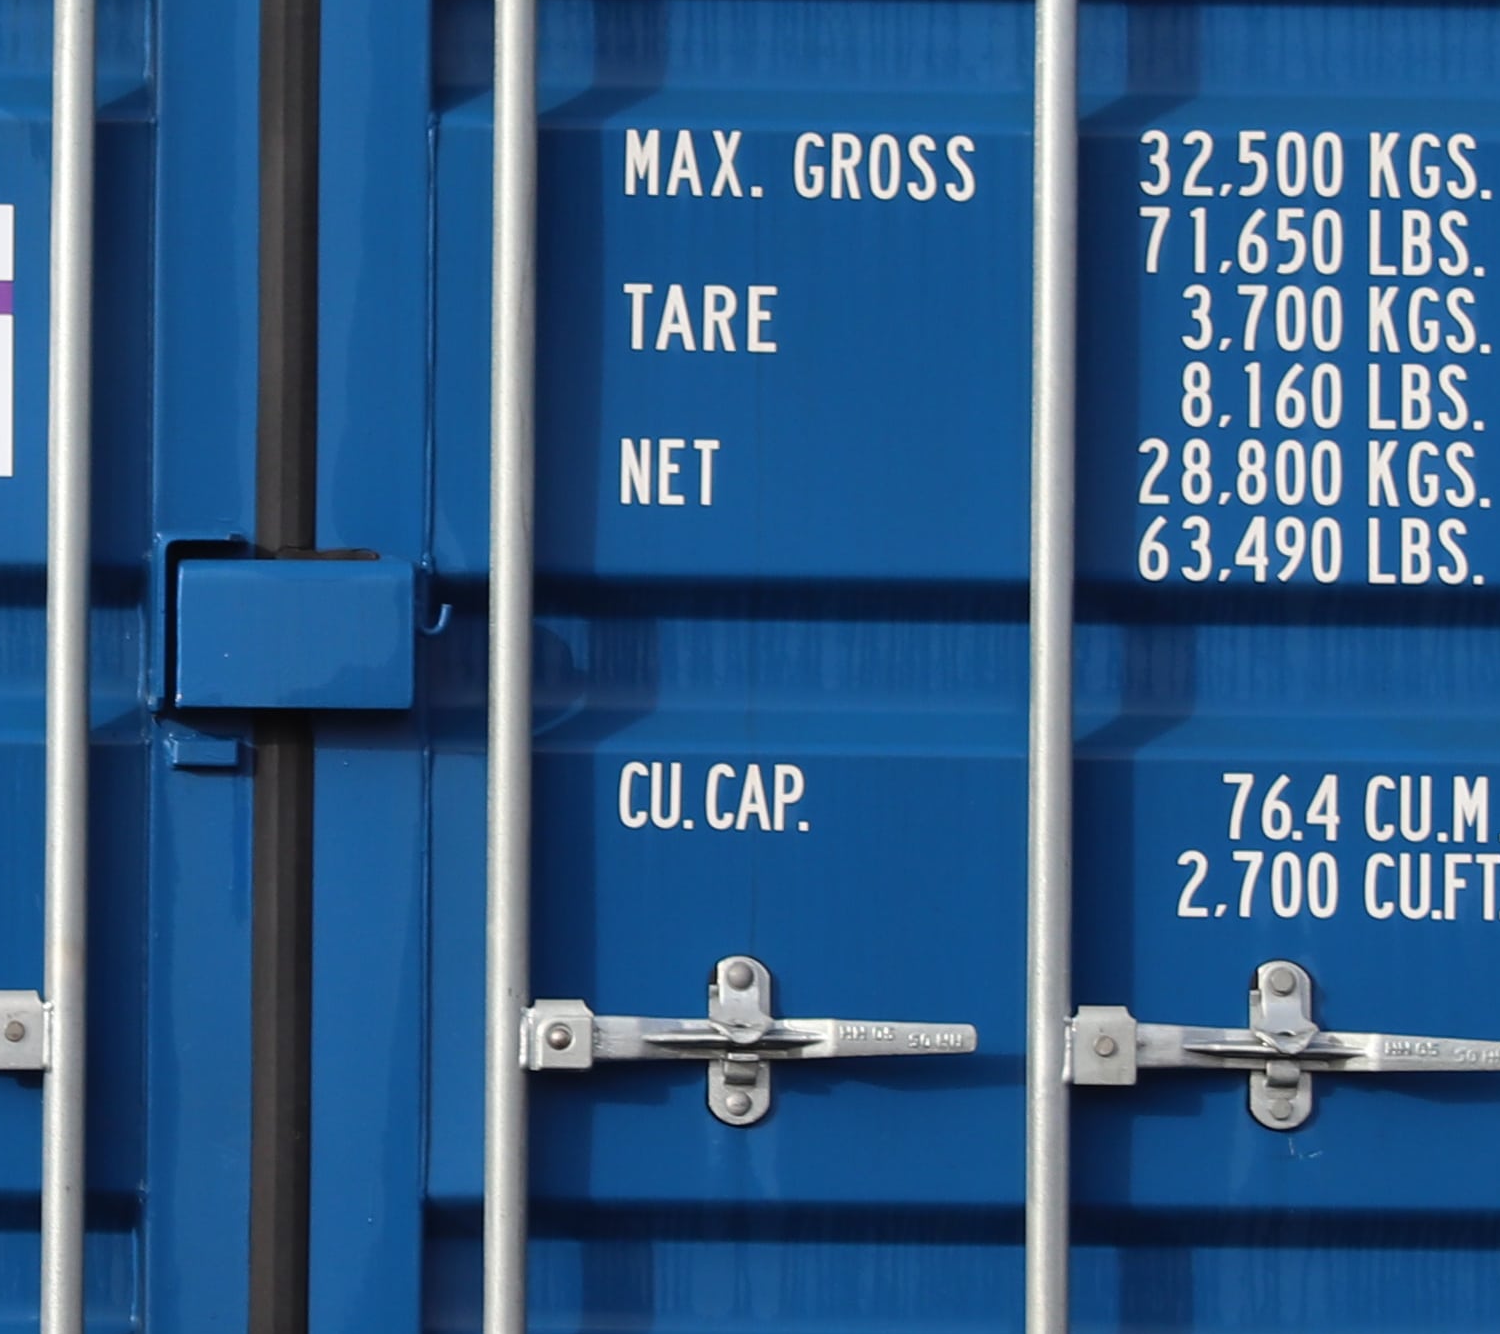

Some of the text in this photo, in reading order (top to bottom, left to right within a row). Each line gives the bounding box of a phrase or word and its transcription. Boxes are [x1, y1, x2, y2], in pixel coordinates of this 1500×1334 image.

[625, 129, 975, 202] MAX. GROSS
[1140, 129, 1492, 200] 32,500 KGS.
[1140, 206, 1485, 277] 71,650 LBS.
[623, 283, 778, 353] TARE
[1182, 284, 1491, 354] 3,700 KGS.
[1181, 361, 1484, 431] 8,160 LBS.
[620, 438, 720, 506] NET
[1139, 437, 1491, 508] 28,800 KGS.
[1138, 515, 1484, 585] 63,490 LBS.
[619, 761, 809, 832] CU. CAP.
[1223, 773, 1340, 841] 76.4
[1177, 850, 1338, 919] 2,700
